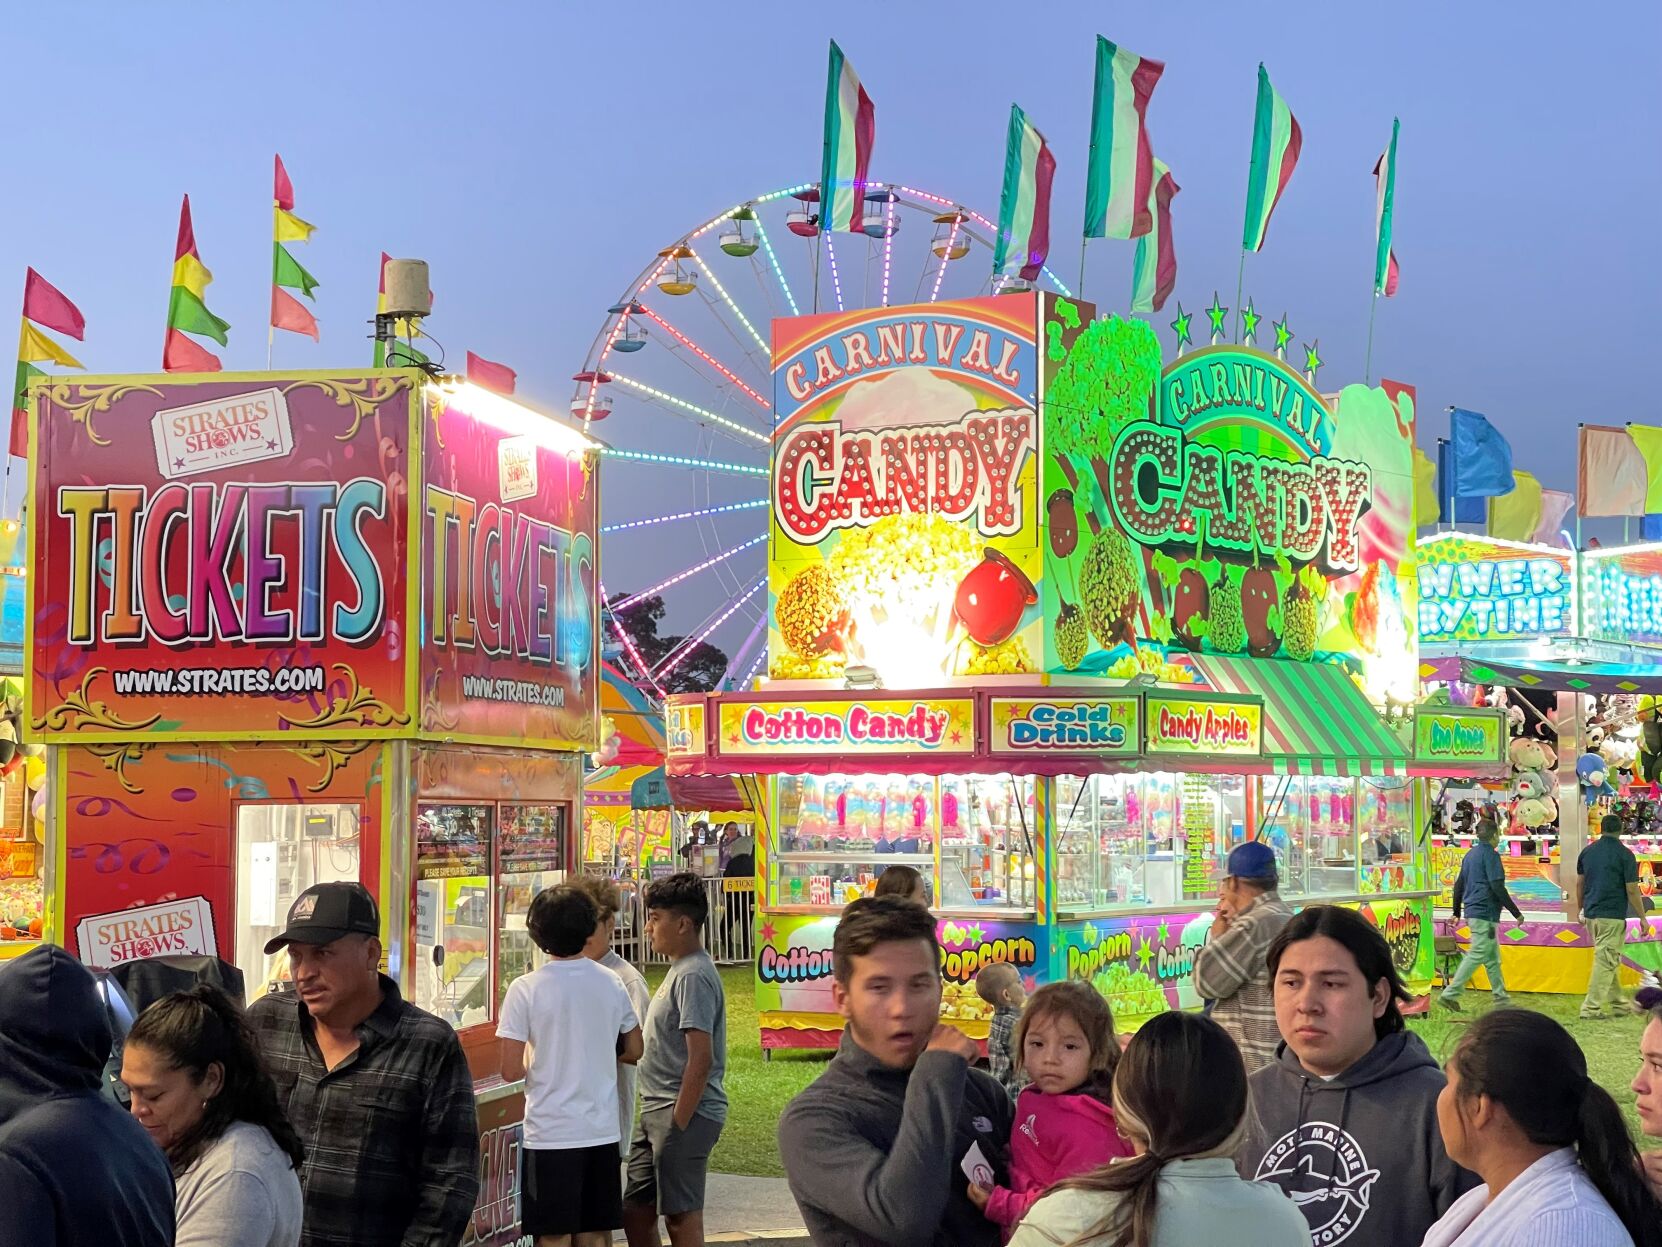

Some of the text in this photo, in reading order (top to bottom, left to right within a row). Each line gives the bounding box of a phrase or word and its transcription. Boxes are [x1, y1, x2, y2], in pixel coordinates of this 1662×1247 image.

[786, 321, 1020, 401] CARNIVAL
[172, 401, 269, 437] STRATES
[1170, 362, 1321, 453] CARNIVAL
[777, 412, 1033, 540] CANDY
[1112, 427, 1370, 567] CANDY
[58, 477, 386, 645] TICKETS
[427, 483, 592, 671] TICKETS
[1417, 559, 1564, 597] NNER
[1418, 595, 1564, 635] RYTIME
[114, 667, 323, 695] WWW.STRATES.COM
[462, 676, 564, 707] WWW.STRATES.COM
[745, 704, 948, 746] Cotton Candy
[1012, 721, 1126, 744] Drinks
[1031, 704, 1110, 723] Cold
[1160, 706, 1249, 745] Candy Apples
[735, 880, 755, 888] TICKE
[97, 910, 193, 945] STRATES
[761, 946, 833, 981] Cotton
[1069, 932, 1131, 981] Popcorn
[1266, 1134, 1303, 1168] MOT
